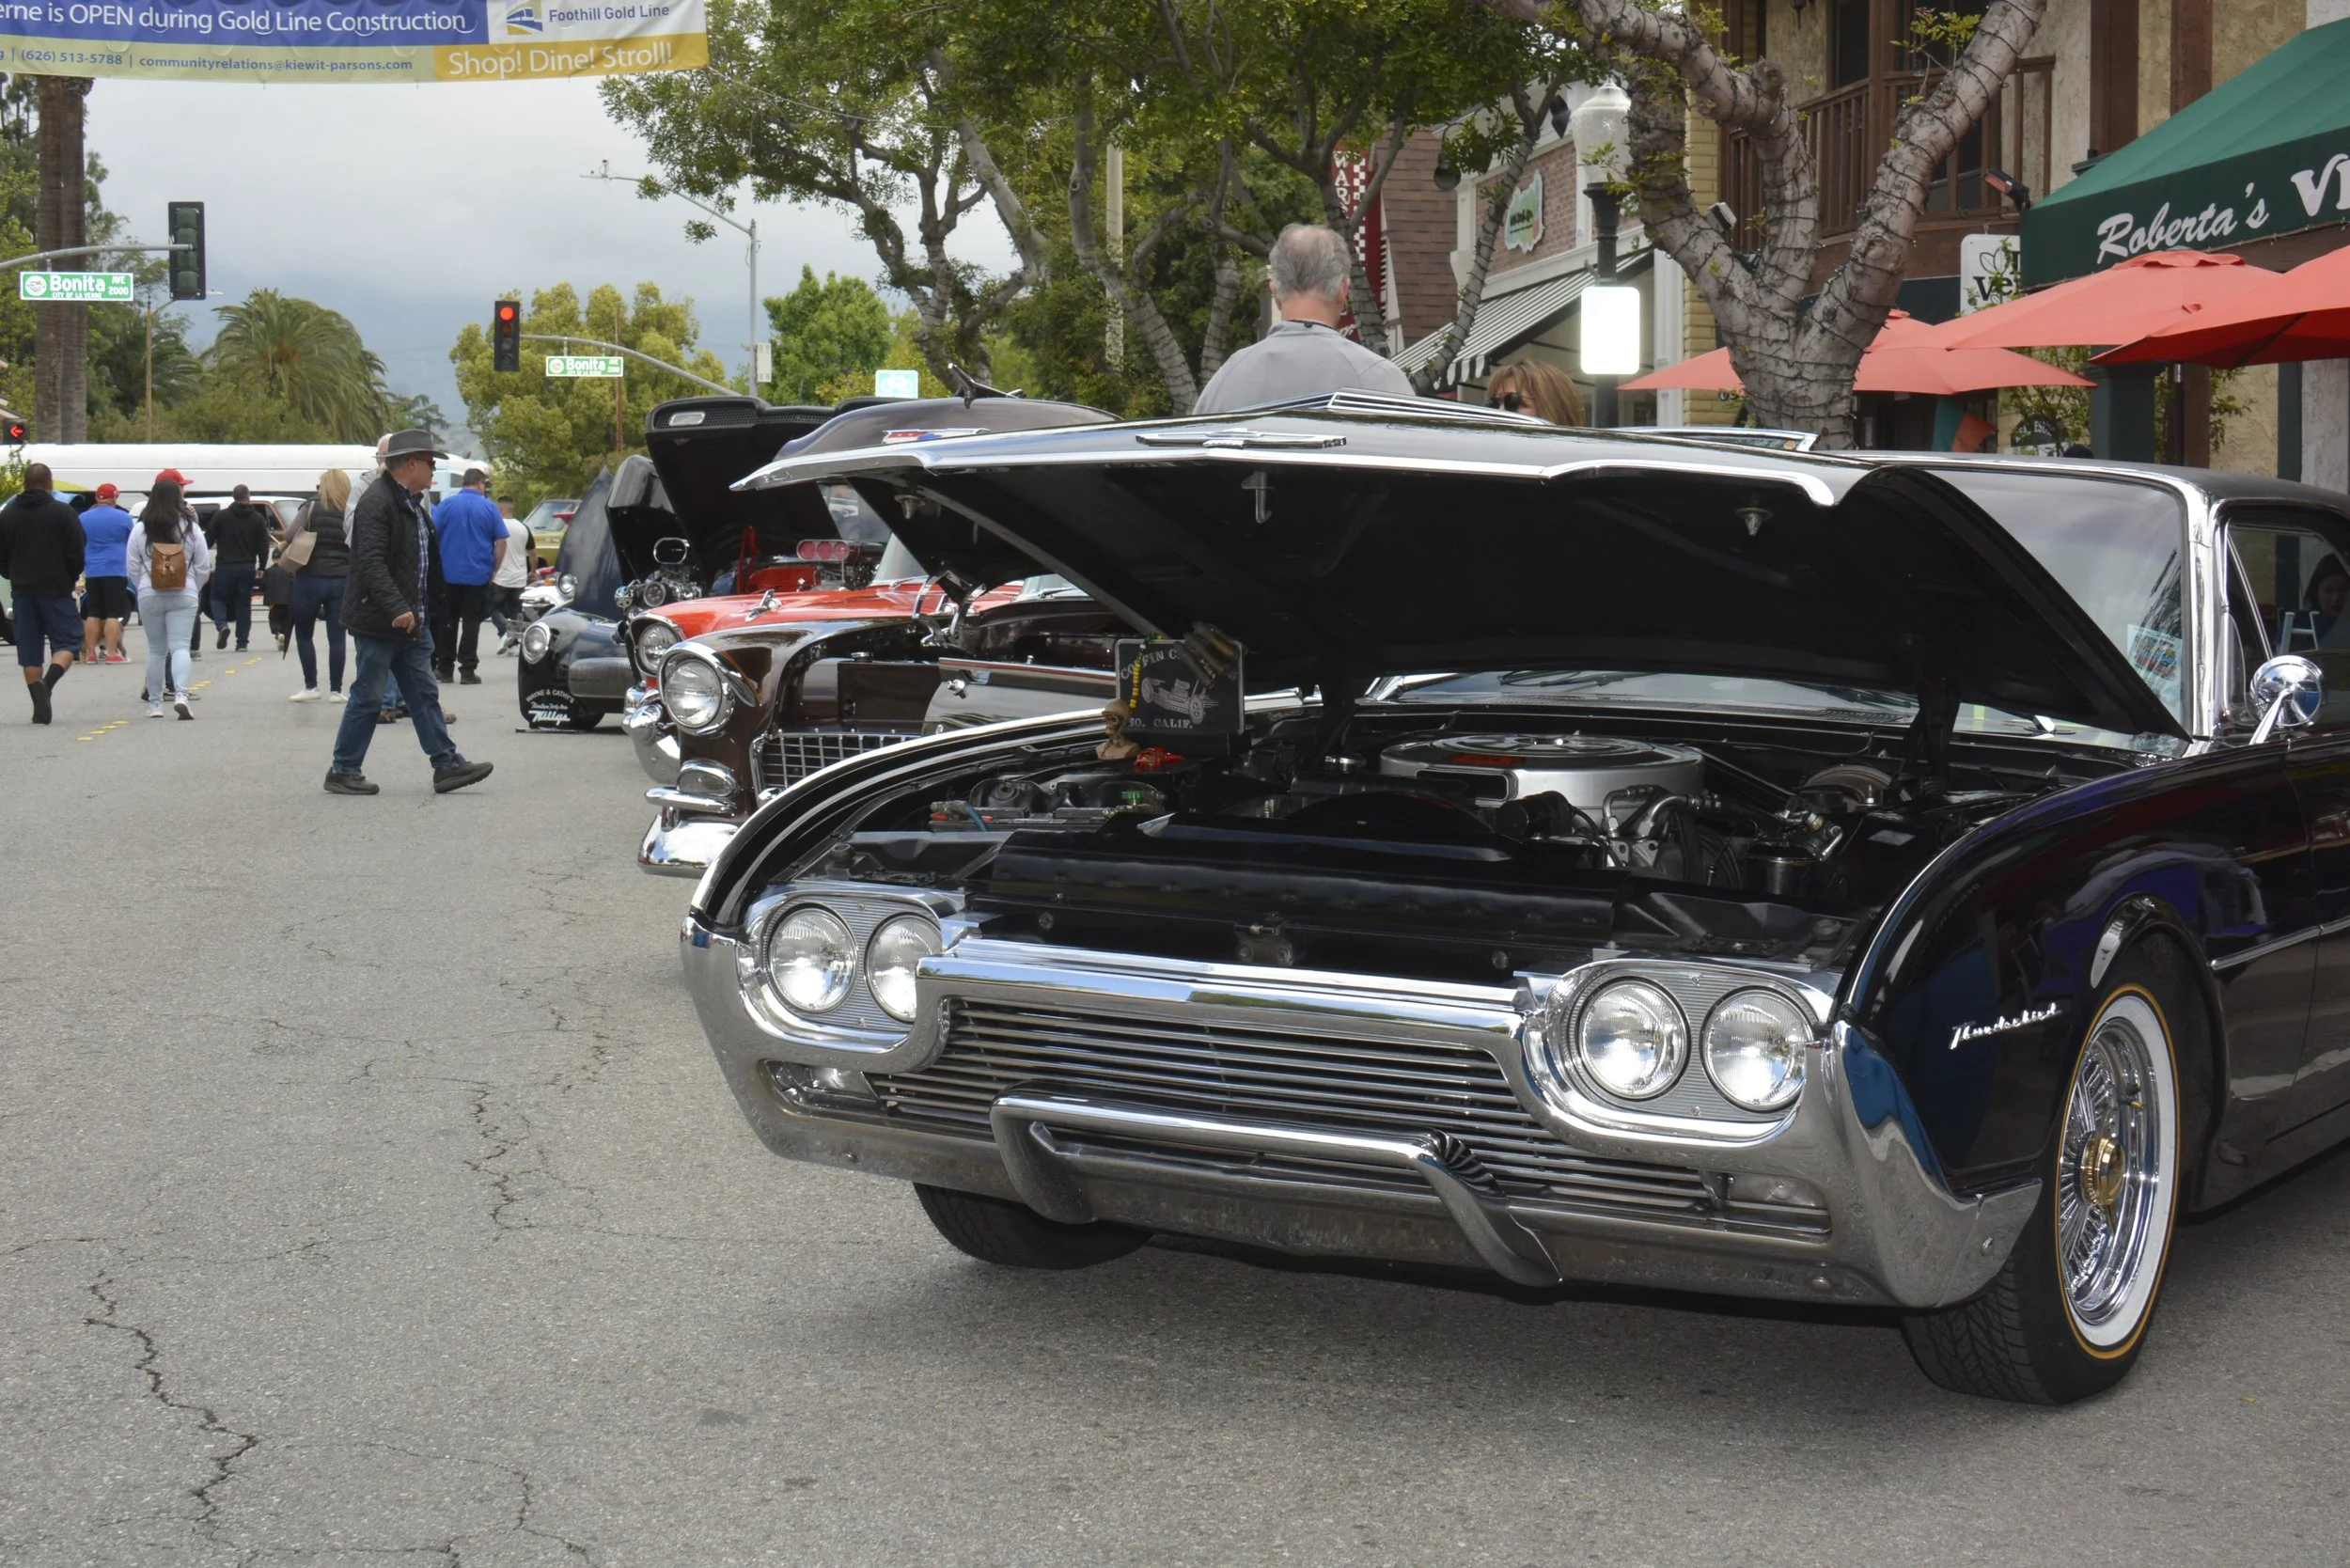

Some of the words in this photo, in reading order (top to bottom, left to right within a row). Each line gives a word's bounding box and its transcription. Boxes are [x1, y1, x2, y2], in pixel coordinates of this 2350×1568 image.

[48, 3, 64, 23] is
[69, 4, 133, 26] OPEN
[138, 7, 212, 34] during
[217, 10, 270, 31] Gold
[275, 11, 321, 31] Line
[326, 11, 466, 32] Construction
[549, 7, 601, 23] Foothill
[604, 7, 635, 20] Gold
[640, 4, 669, 18] Line
[21, 50, 55, 62] (626)
[60, 52, 123, 65] 513-5788
[139, 55, 413, 72] communityrelations@kiewit-parsons.com
[448, 51, 522, 79] Shop!
[530, 48, 595, 72] Dine!
[602, 41, 672, 68] Stroll!
[2096, 182, 2269, 265] Roberta's
[50, 274, 105, 292] Bonita
[112, 275, 126, 285] AVE
[108, 286, 129, 296] 2000
[566, 358, 606, 371] Bonita
[1120, 649, 1165, 680] COFIN
[1129, 717, 1146, 729] SO.
[1153, 717, 1193, 729] CALIF.
